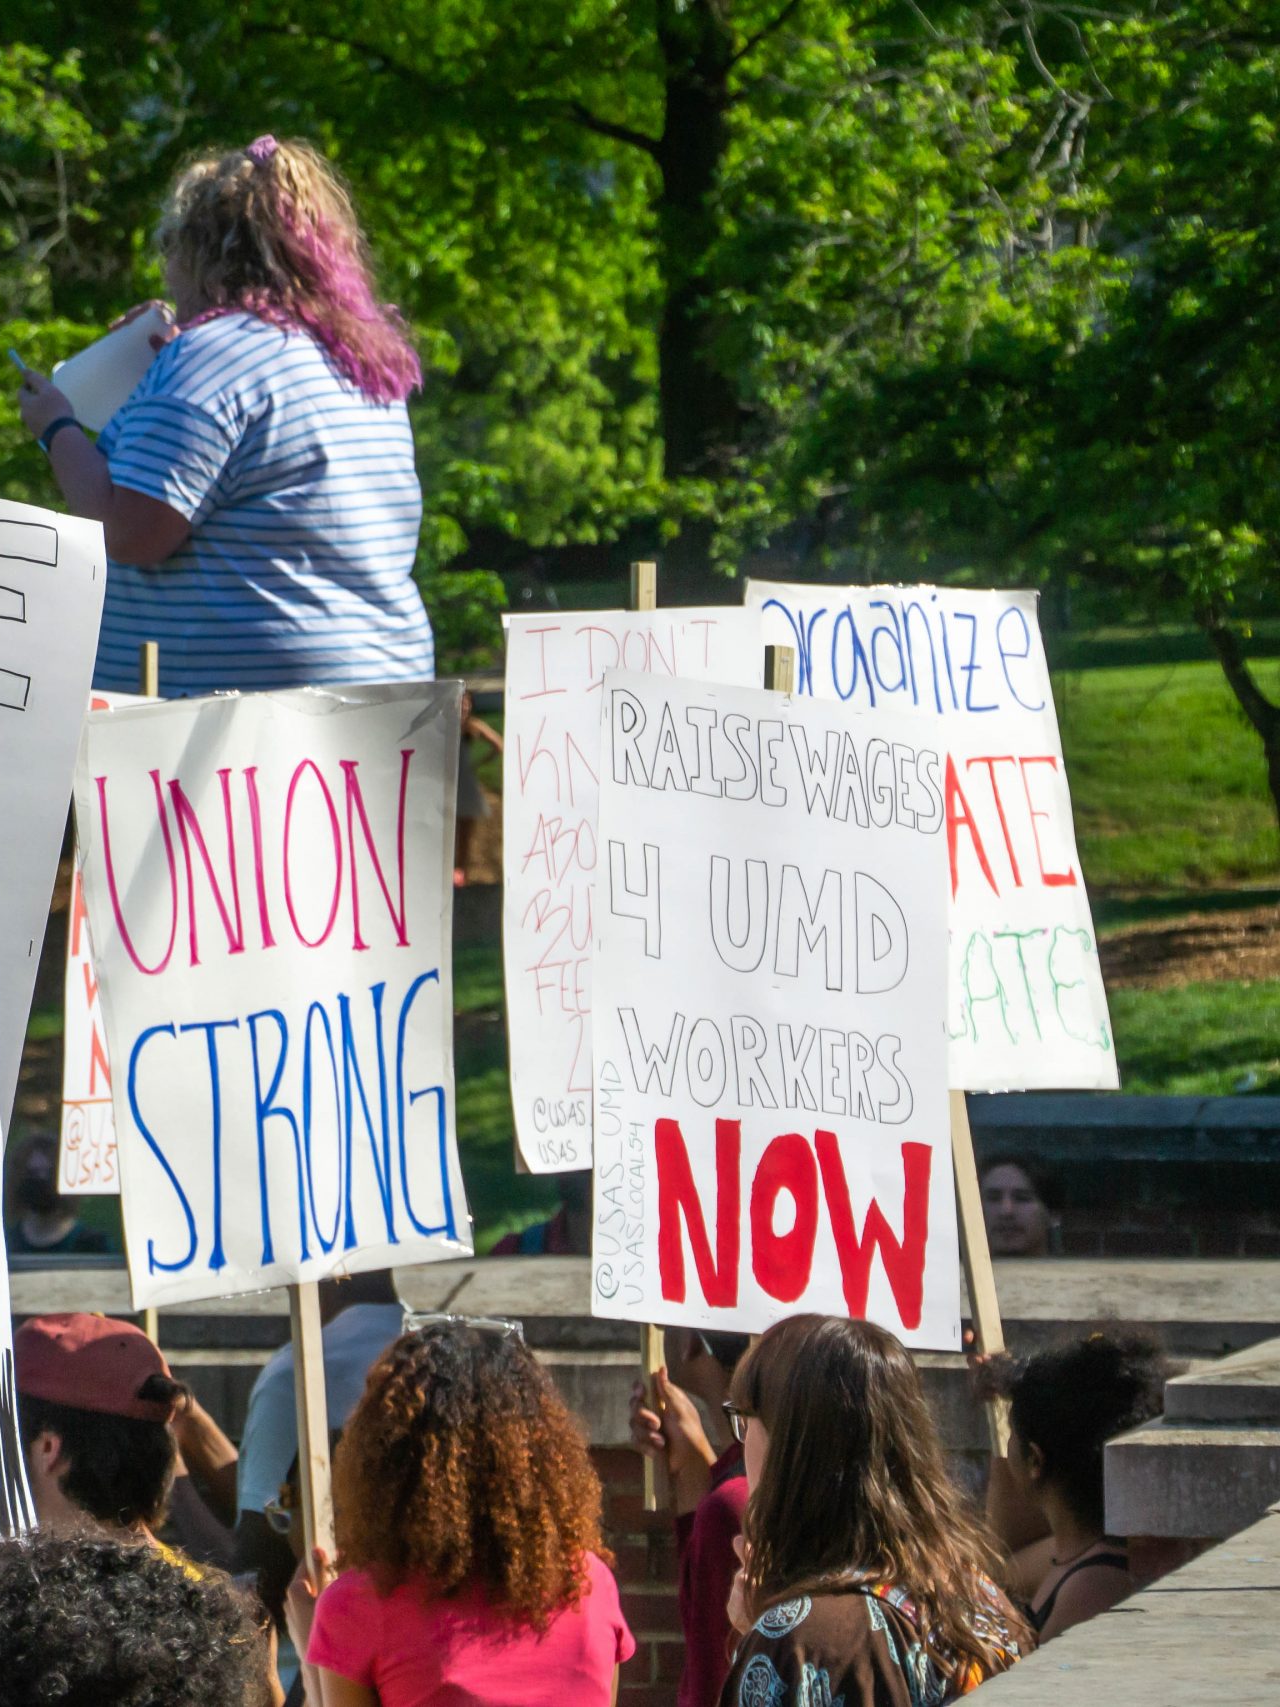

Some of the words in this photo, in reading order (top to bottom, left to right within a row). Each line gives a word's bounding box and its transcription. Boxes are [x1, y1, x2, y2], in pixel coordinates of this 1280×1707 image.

[520, 626, 567, 700] I
[575, 620, 718, 692] DON'T
[611, 688, 787, 808] RAISE
[789, 724, 945, 834] WAGES
[95, 749, 415, 975] UNION
[608, 839, 662, 960] 4
[710, 854, 910, 995] UMD
[127, 968, 458, 1277] STRONG
[532, 1097, 593, 1133] @USAS
[618, 1007, 914, 1125] WORKERS
[654, 1116, 933, 1331] NOW
